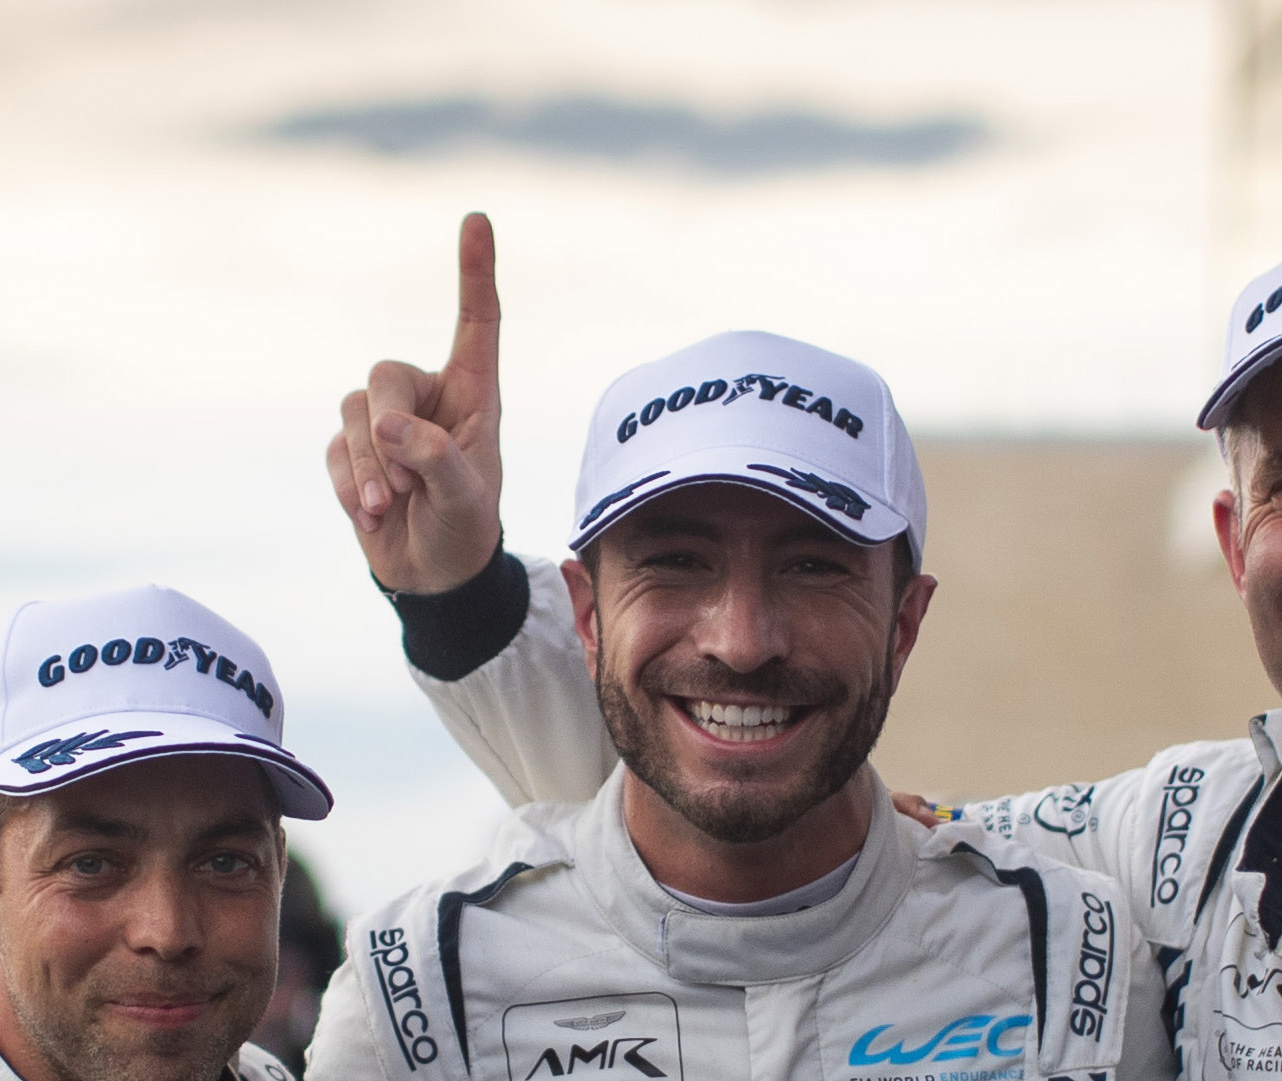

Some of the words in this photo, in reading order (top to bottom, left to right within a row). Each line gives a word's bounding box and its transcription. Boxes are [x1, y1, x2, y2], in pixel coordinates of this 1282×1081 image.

[616, 374, 864, 443] GOODYEAR
[38, 637, 274, 719] GOODYEAR
[1155, 766, 1204, 906] sparco
[371, 928, 438, 1070] sparco
[1070, 892, 1112, 1040] sparco
[525, 1037, 668, 1081] AMR
[848, 1014, 1033, 1066] WEC
[1230, 1042, 1255, 1057] THE
